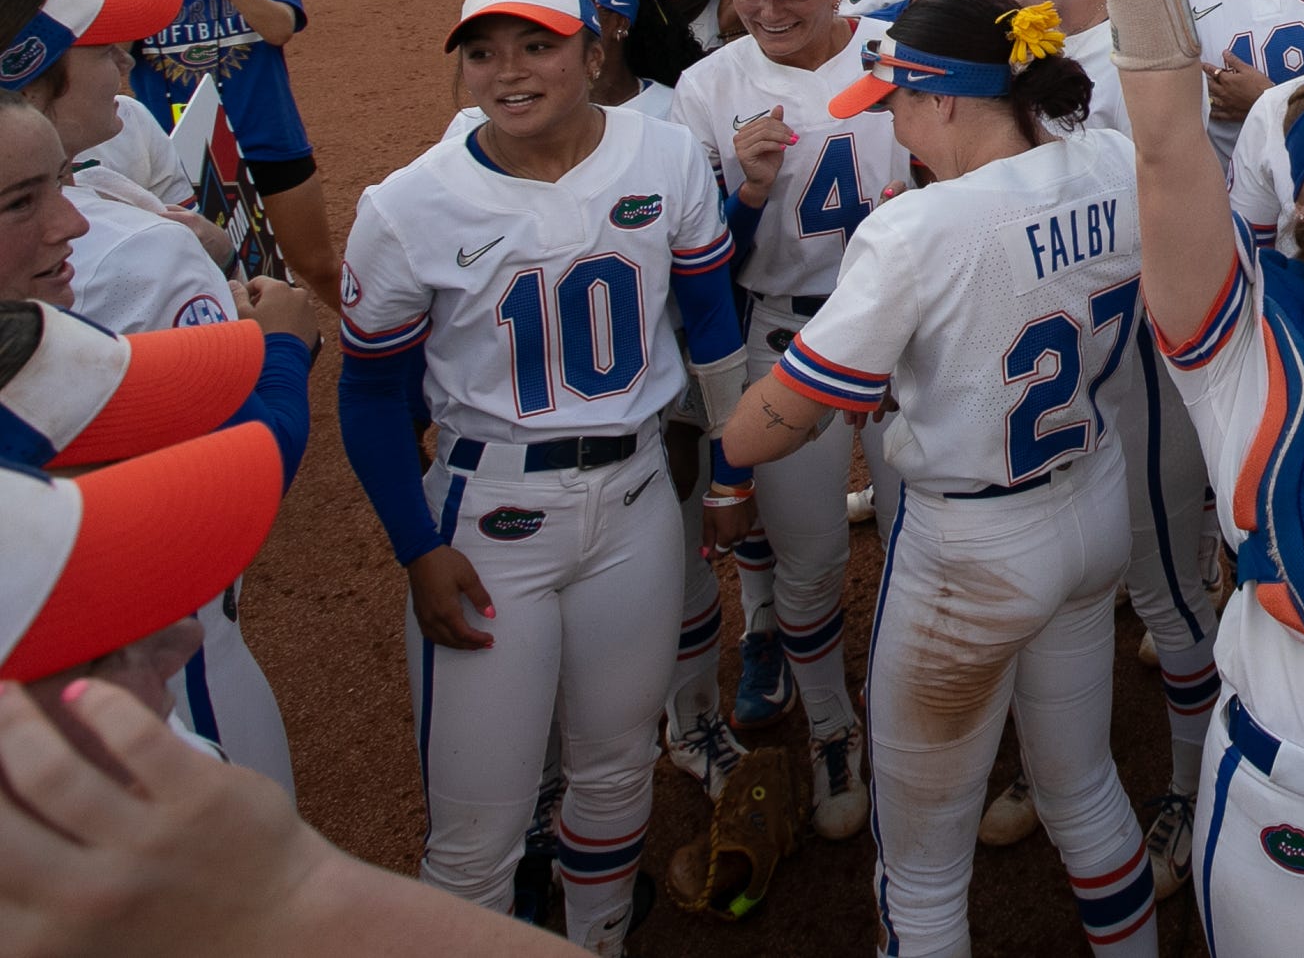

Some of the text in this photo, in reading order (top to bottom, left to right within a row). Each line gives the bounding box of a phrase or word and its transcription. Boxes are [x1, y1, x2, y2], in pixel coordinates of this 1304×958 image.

[795, 132, 873, 251] 4
[1025, 198, 1117, 280] FALBY
[497, 251, 649, 419] 10
[1002, 272, 1142, 488] 27
